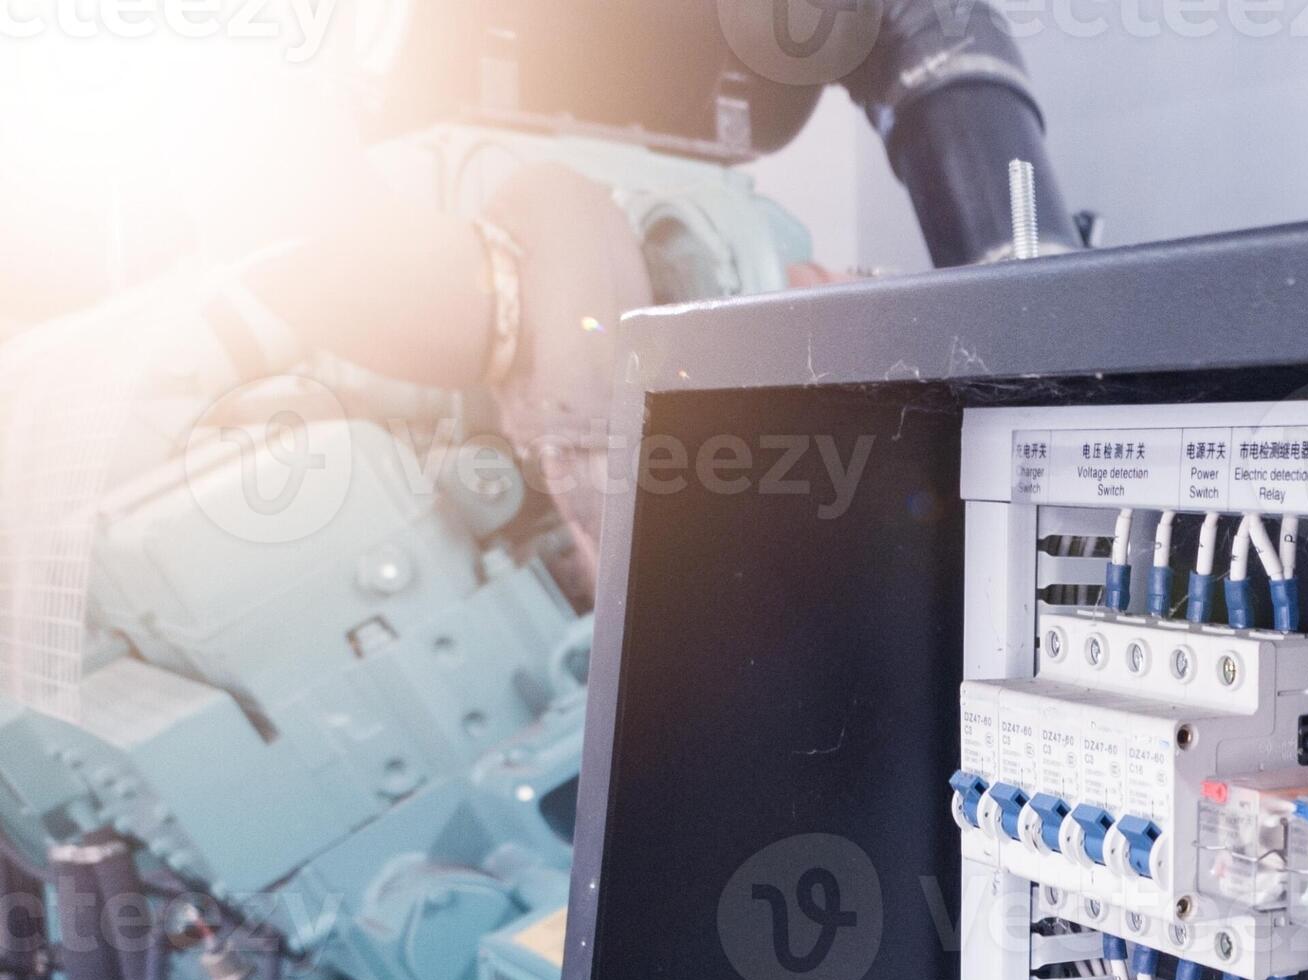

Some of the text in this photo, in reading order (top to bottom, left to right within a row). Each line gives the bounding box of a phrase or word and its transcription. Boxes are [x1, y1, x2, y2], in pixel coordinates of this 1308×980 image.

[1082, 442, 1145, 460] 电压检测开关
[1186, 441, 1227, 460] 电源开关
[1077, 466, 1149, 481] Voltage detection
[1191, 467, 1220, 480] Power
[1234, 467, 1268, 481] Electric
[1018, 482, 1041, 494] Switch
[1097, 483, 1125, 497] Switch
[1189, 485, 1219, 499] Switch
[1259, 487, 1286, 504] Relay
[963, 711, 992, 727] DZ47-60
[1001, 721, 1032, 737] DZ47-60
[1042, 730, 1075, 747] DZ47-60
[1084, 738, 1118, 755] DZ47-60
[1129, 747, 1165, 764] DZ47-60
